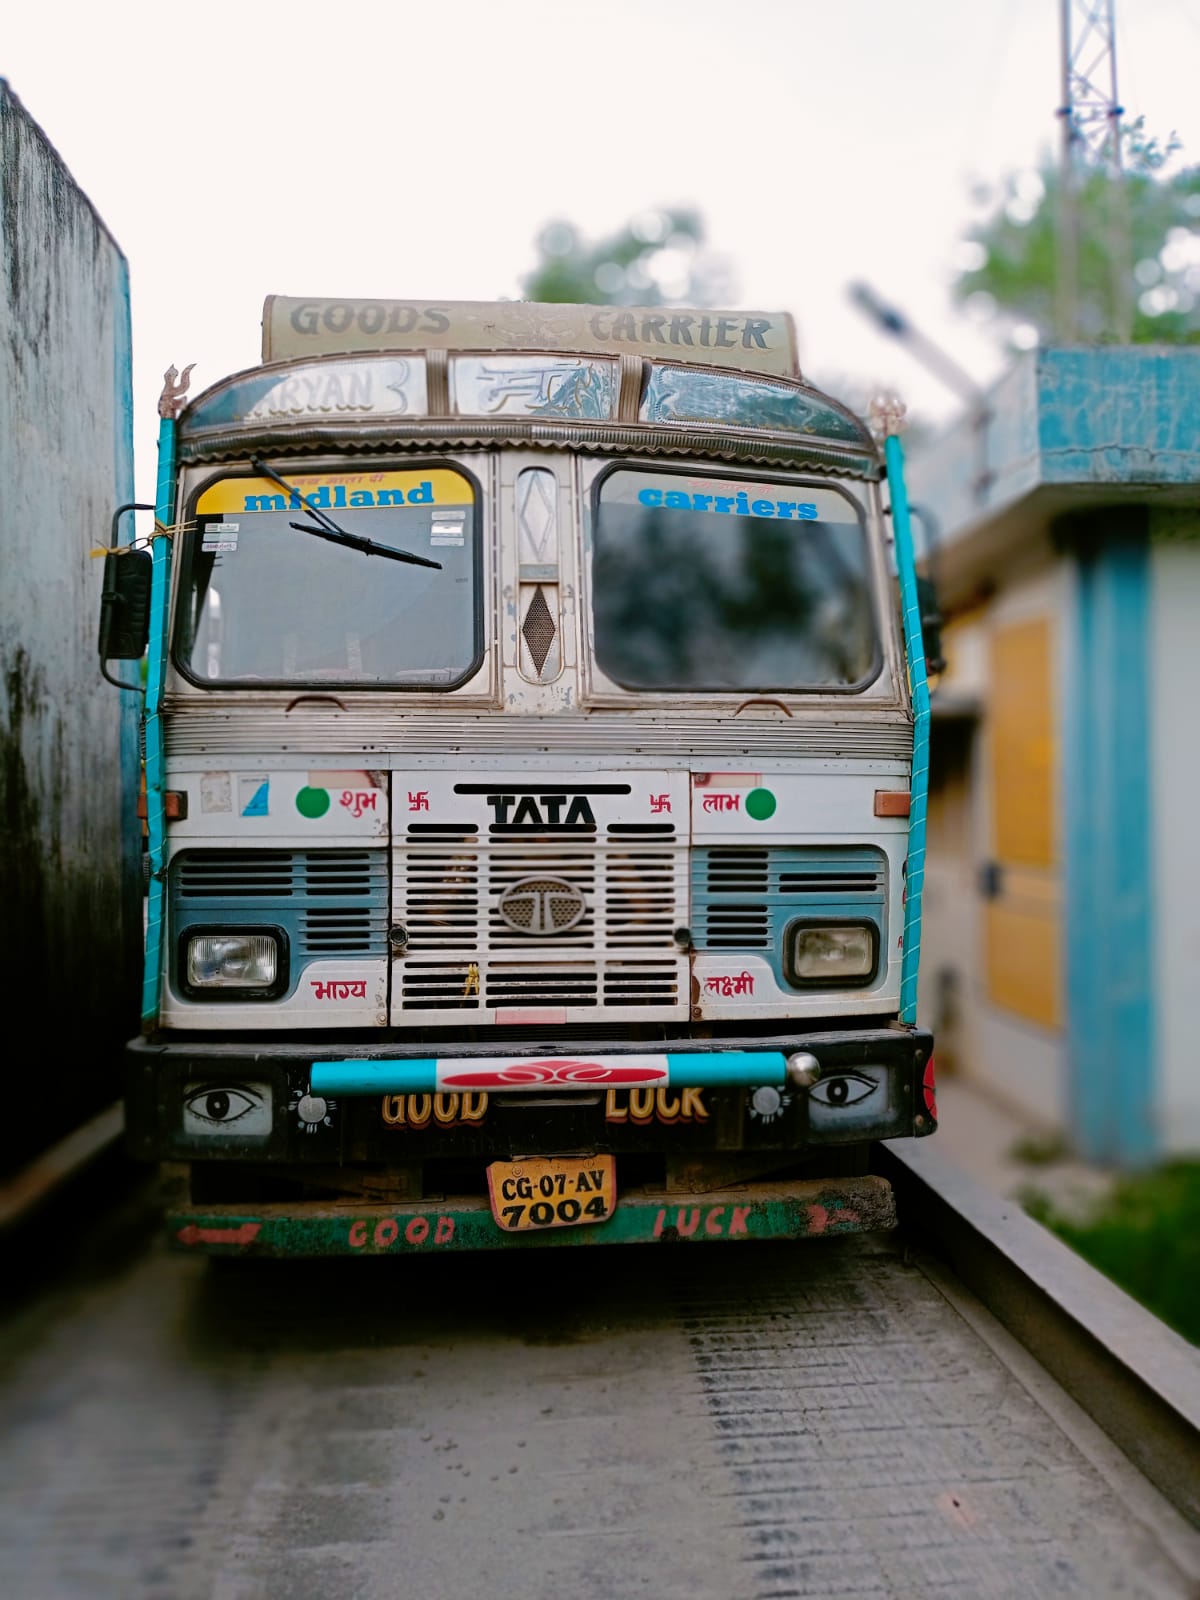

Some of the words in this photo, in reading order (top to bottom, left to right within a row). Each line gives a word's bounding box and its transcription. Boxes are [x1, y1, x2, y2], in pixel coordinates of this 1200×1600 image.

[290, 303, 451, 335] GOODS
[589, 311, 774, 350] CARRIER
[244, 481, 434, 511] midland
[638, 487, 818, 520] carriers
[339, 790, 377, 818] शुभ
[487, 796, 596, 824] TATA
[702, 794, 740, 813] लाभ
[310, 980, 367, 1000] भाग्य
[704, 971, 755, 998] लक्ष्मी
[605, 1088, 710, 1122] LUCK
[502, 1169, 604, 1200] CG-07-AV
[502, 1197, 608, 1227] 7004
[348, 1216, 455, 1247] GOOD
